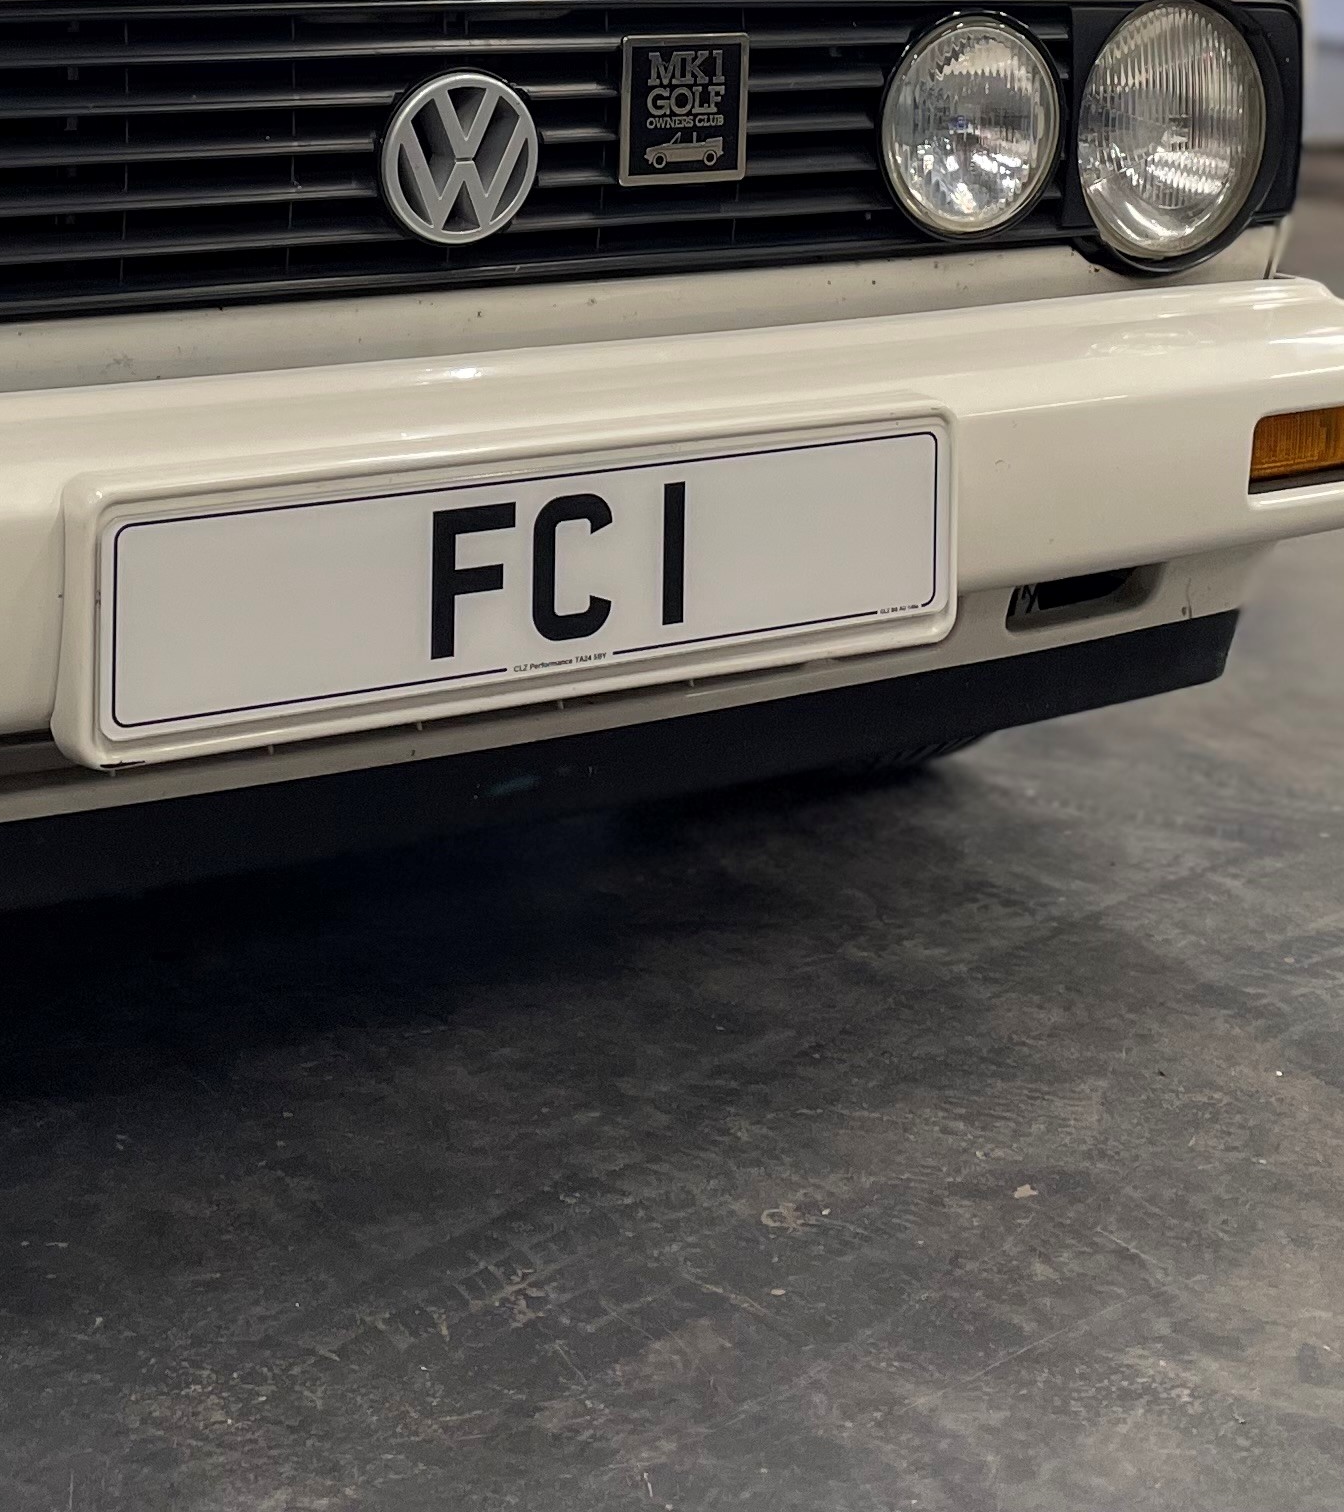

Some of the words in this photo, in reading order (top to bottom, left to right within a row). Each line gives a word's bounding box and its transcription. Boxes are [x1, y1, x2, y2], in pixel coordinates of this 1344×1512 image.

[646, 85, 726, 116] GOLF
[646, 116, 694, 129] OWNERS
[695, 114, 724, 127] CLUB
[383, 72, 538, 244] VW
[430, 494, 613, 660] FC
[514, 664, 528, 672] CLZ
